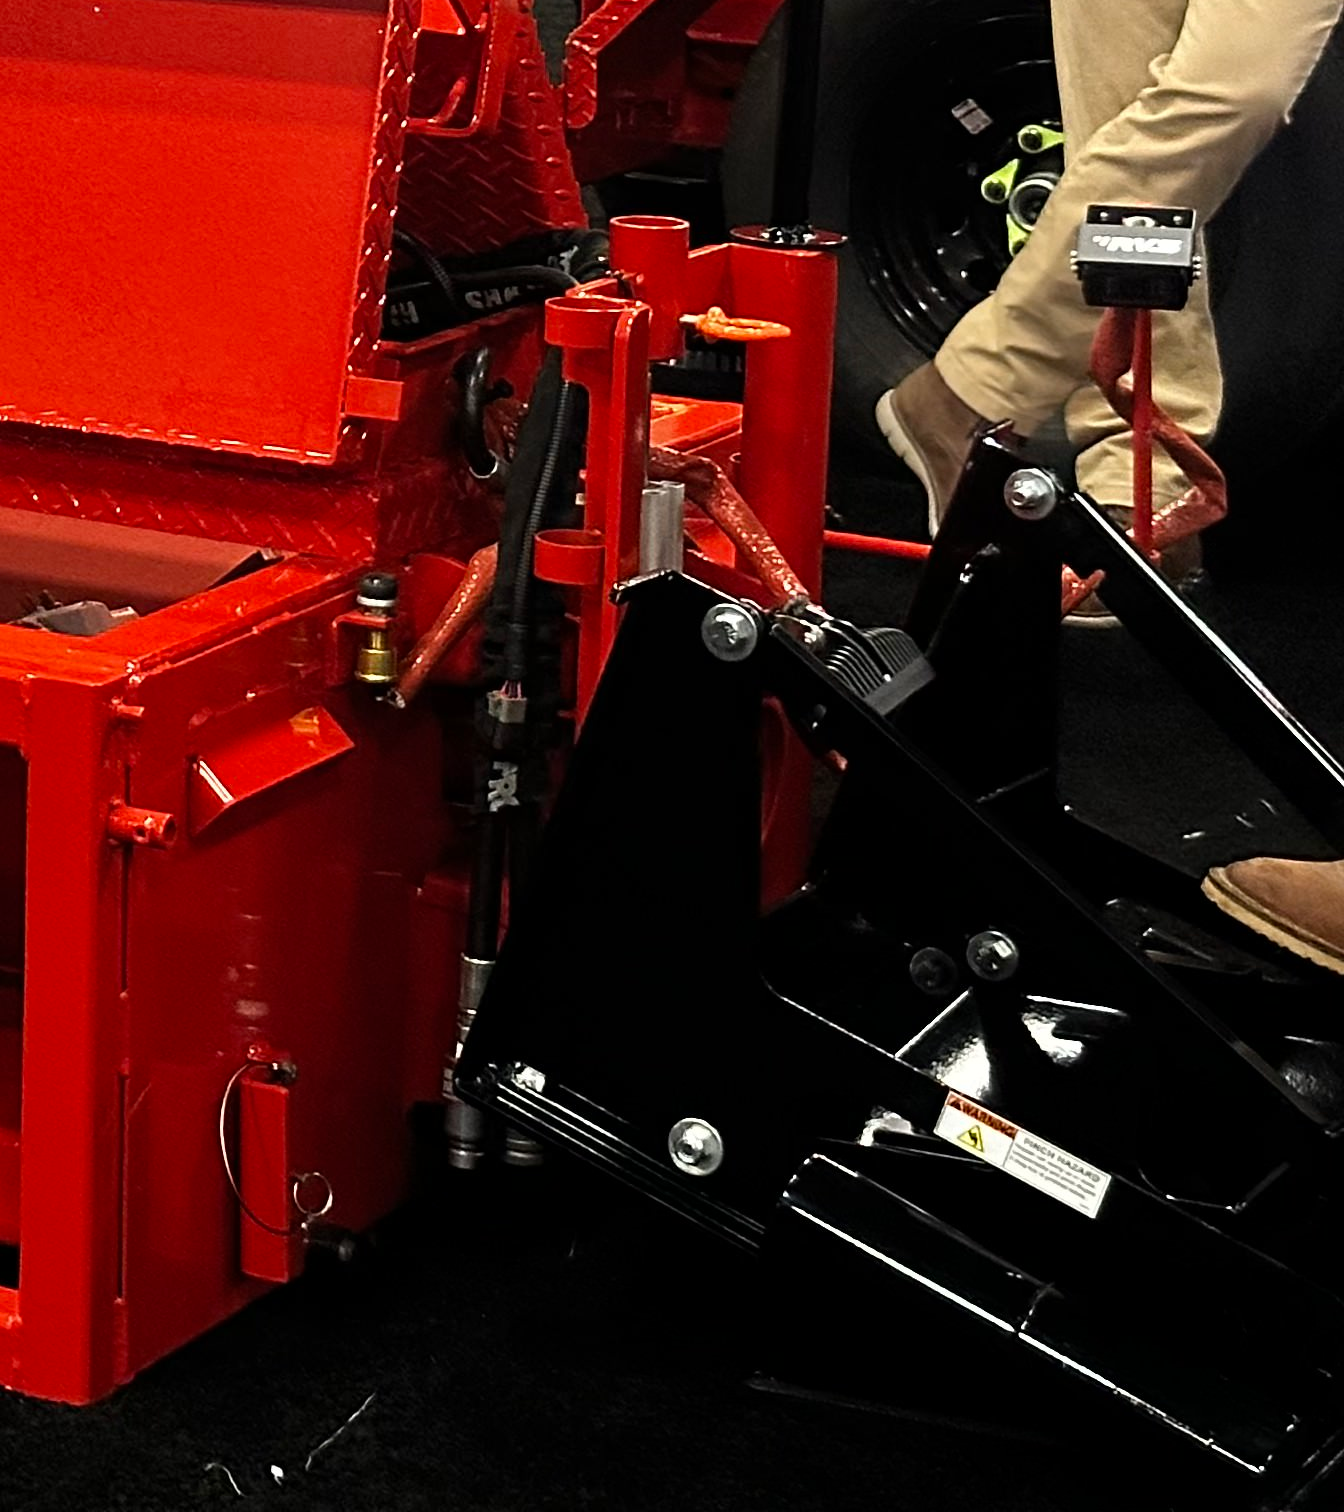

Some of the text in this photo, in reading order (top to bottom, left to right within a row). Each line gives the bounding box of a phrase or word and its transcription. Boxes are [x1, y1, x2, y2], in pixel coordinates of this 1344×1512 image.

[961, 1099, 1017, 1138] WARNING
[1023, 1137, 1101, 1183] PINCH HAZARD
